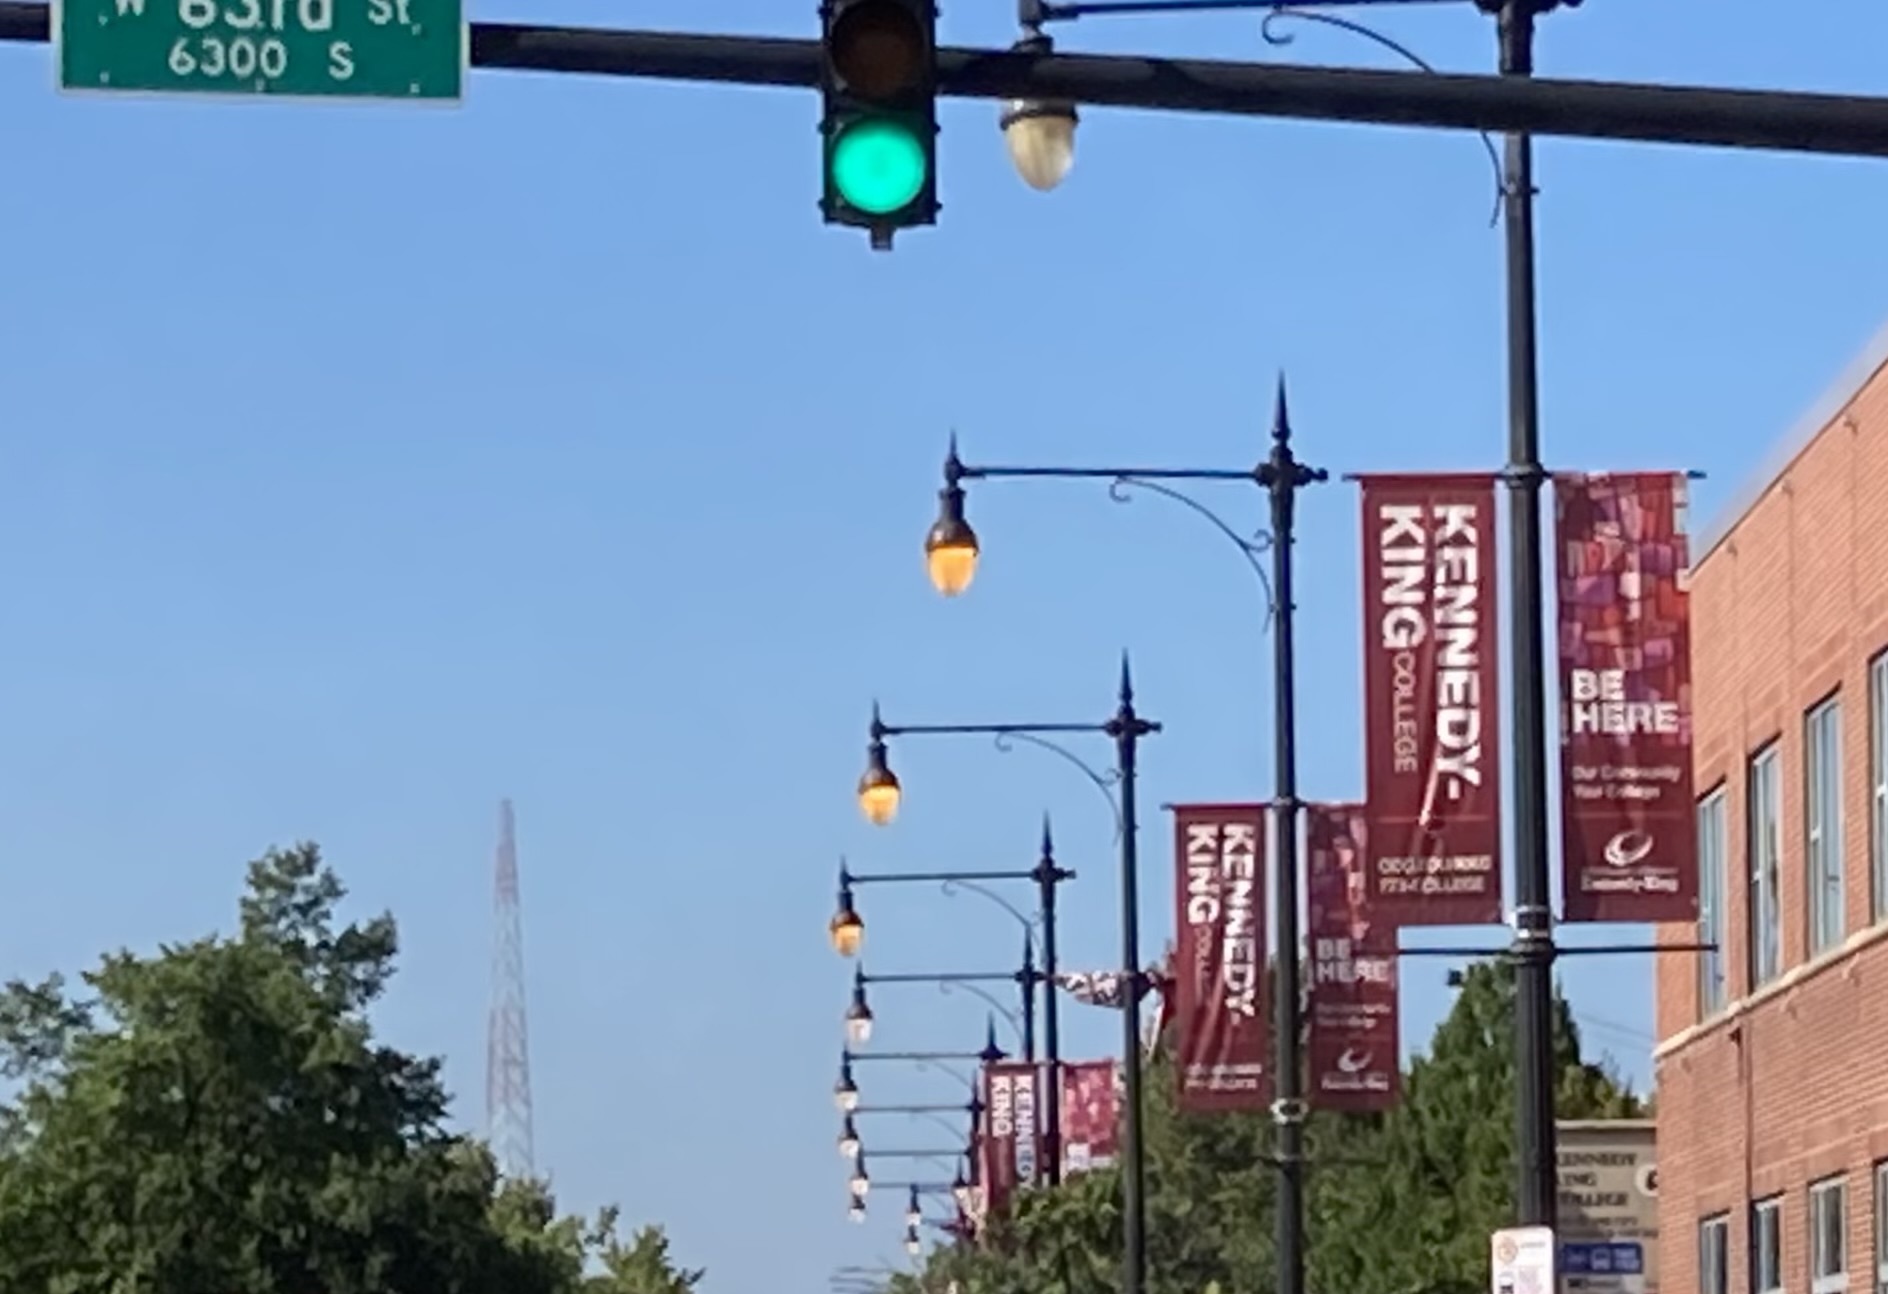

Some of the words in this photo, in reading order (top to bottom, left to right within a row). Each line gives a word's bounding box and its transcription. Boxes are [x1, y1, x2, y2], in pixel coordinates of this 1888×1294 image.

[168, 37, 287, 79] 6300
[328, 42, 355, 80] S
[1380, 504, 1427, 649] KING
[1393, 650, 1418, 773] COLLEGE
[1572, 669, 1624, 701] BE
[1573, 702, 1679, 734] HERE
[1187, 823, 1221, 924] KING
